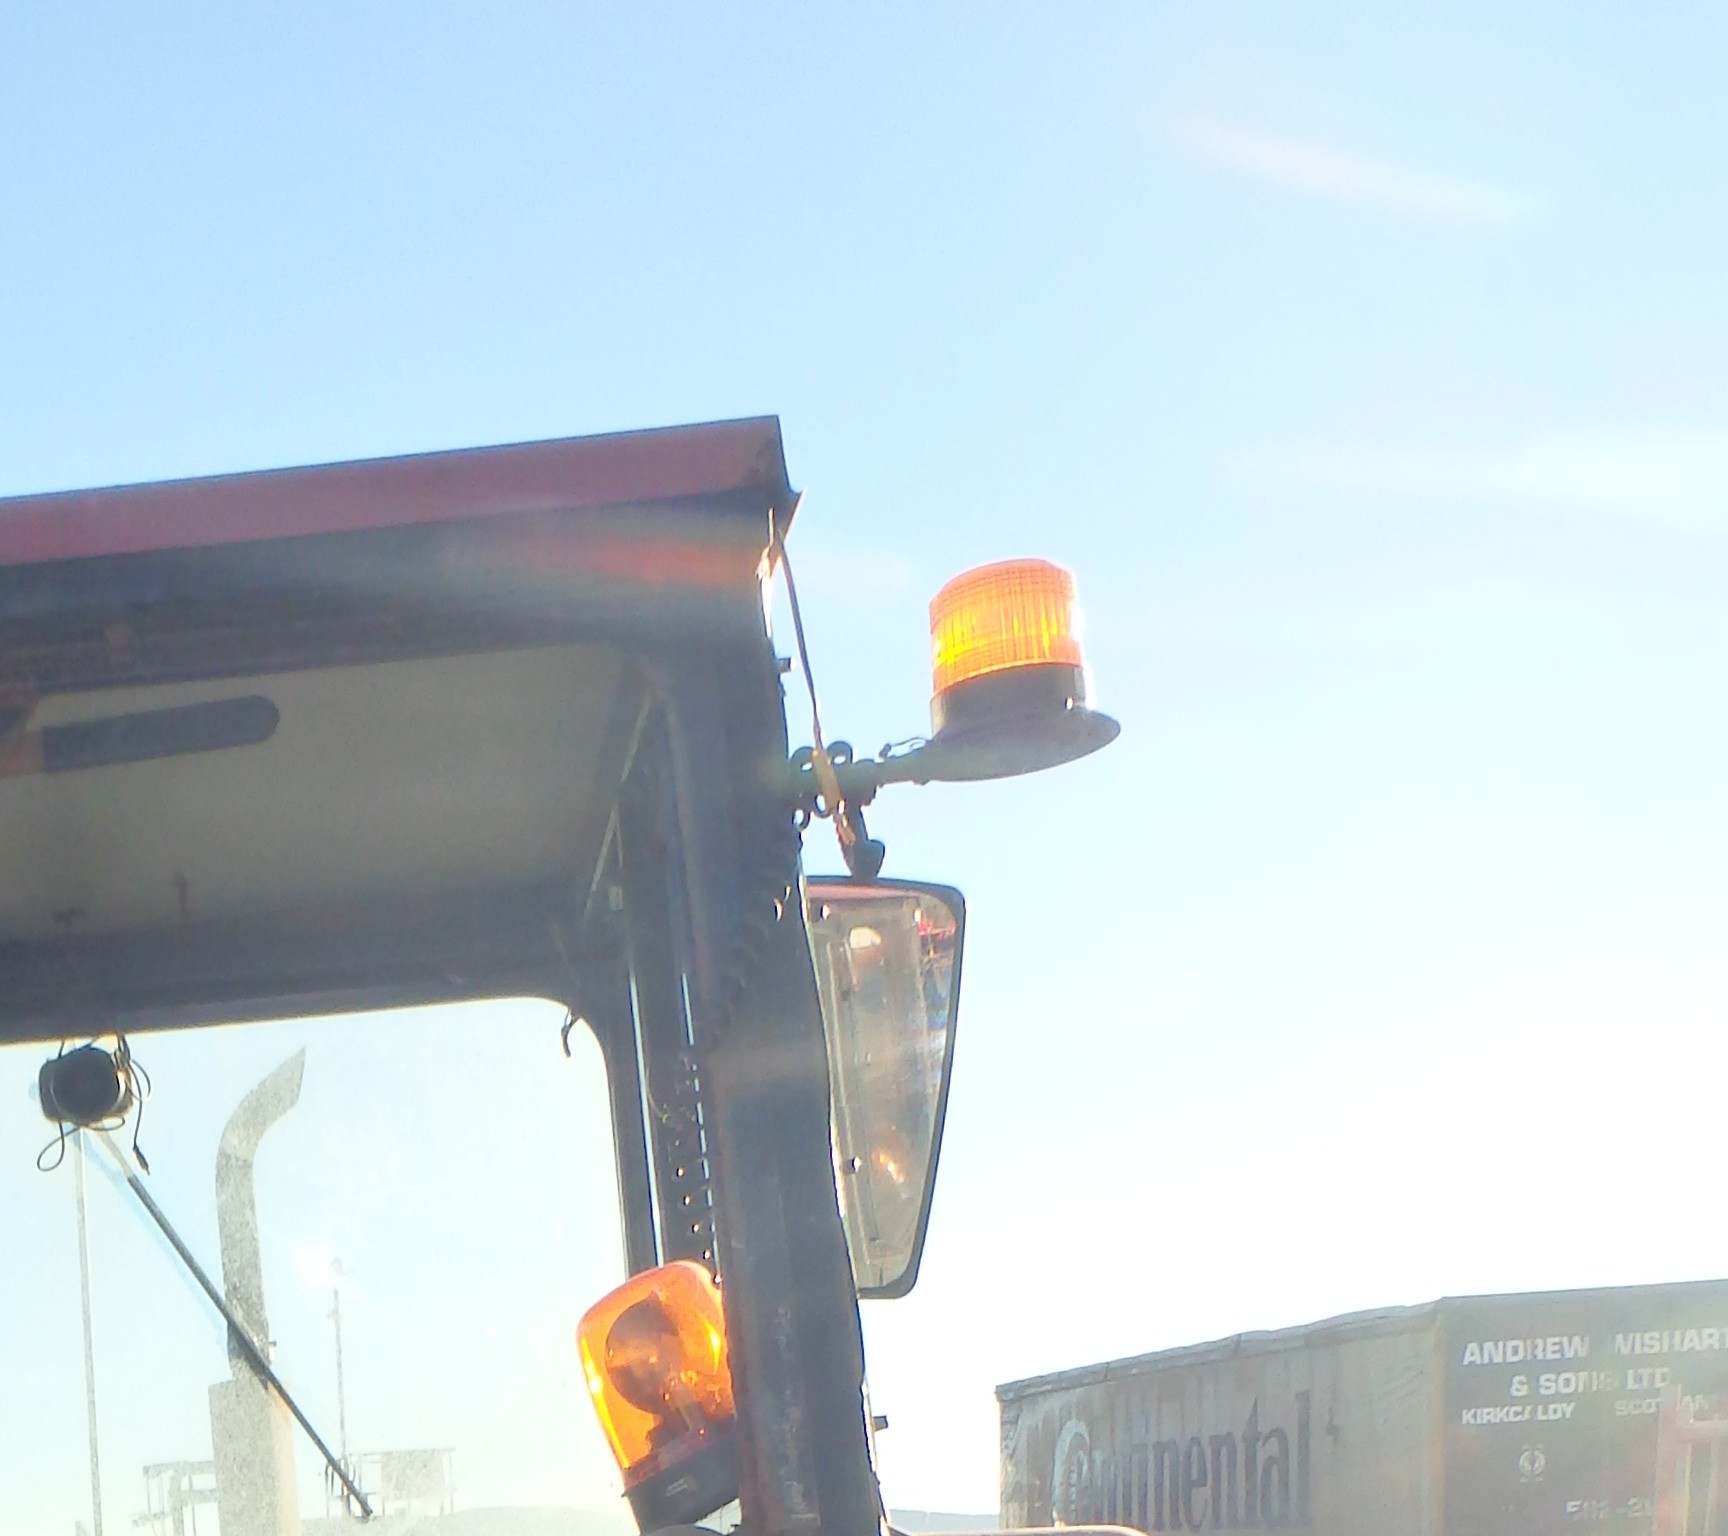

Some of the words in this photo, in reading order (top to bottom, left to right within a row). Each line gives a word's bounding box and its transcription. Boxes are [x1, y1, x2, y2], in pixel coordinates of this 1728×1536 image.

[1462, 1335, 1590, 1366] ANDREW
[1509, 1374, 1529, 1398] &
[1625, 1366, 1671, 1391] LTD
